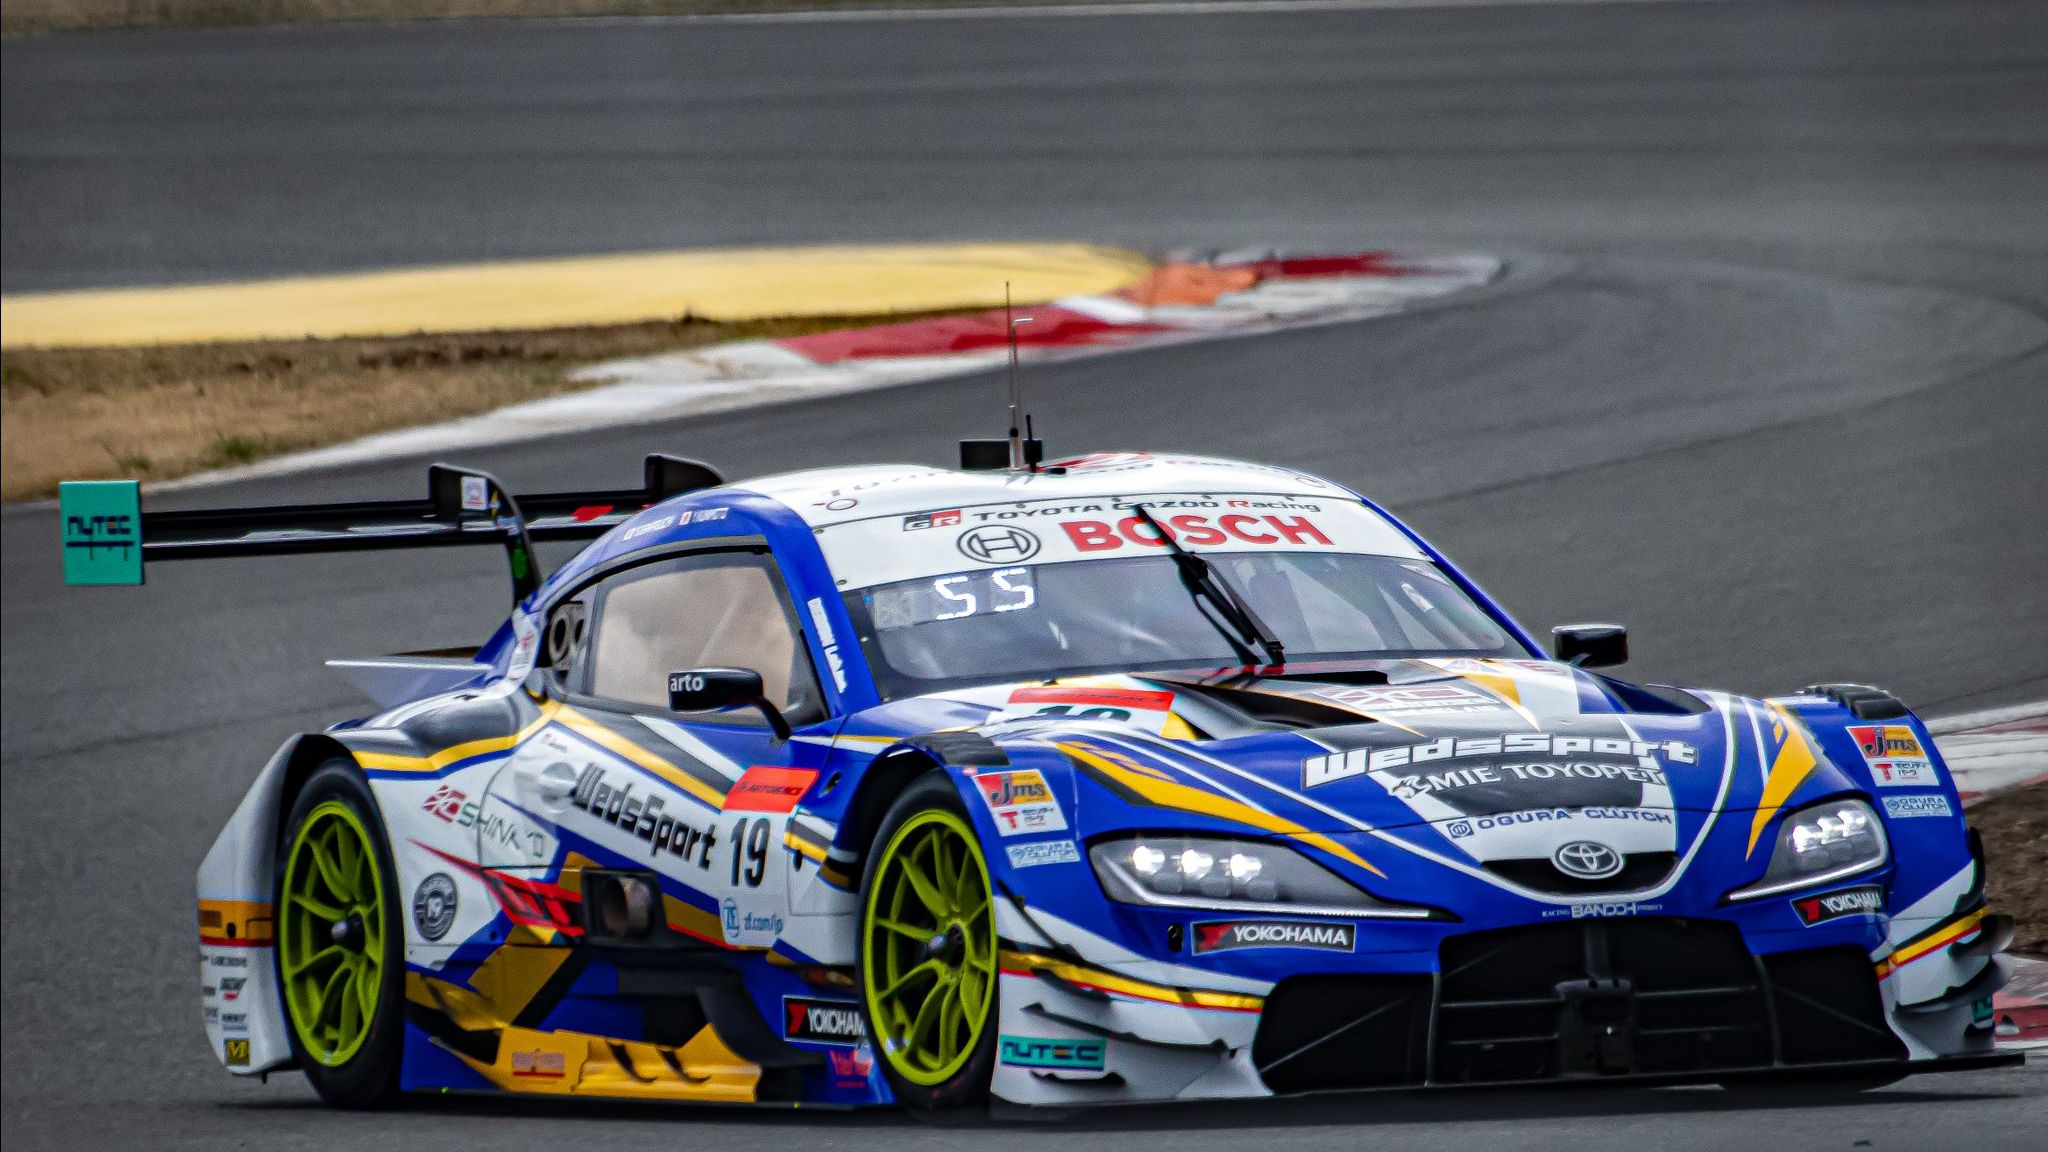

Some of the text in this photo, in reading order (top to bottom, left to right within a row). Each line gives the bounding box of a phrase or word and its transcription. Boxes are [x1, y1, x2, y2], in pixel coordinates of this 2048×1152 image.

[971, 504, 1103, 520] TOYOTA
[1228, 499, 1321, 513] Racing
[1059, 514, 1335, 552] BOSCH
[670, 674, 705, 691] arto
[1304, 733, 1699, 788] WedsSport
[1431, 763, 1666, 792] MIE TOYOPET
[1585, 808, 1672, 824] CLUTCH
[731, 817, 771, 888] 19
[1233, 925, 1348, 946] YOKOHAMA
[808, 1008, 866, 1036] YOKOHAM
